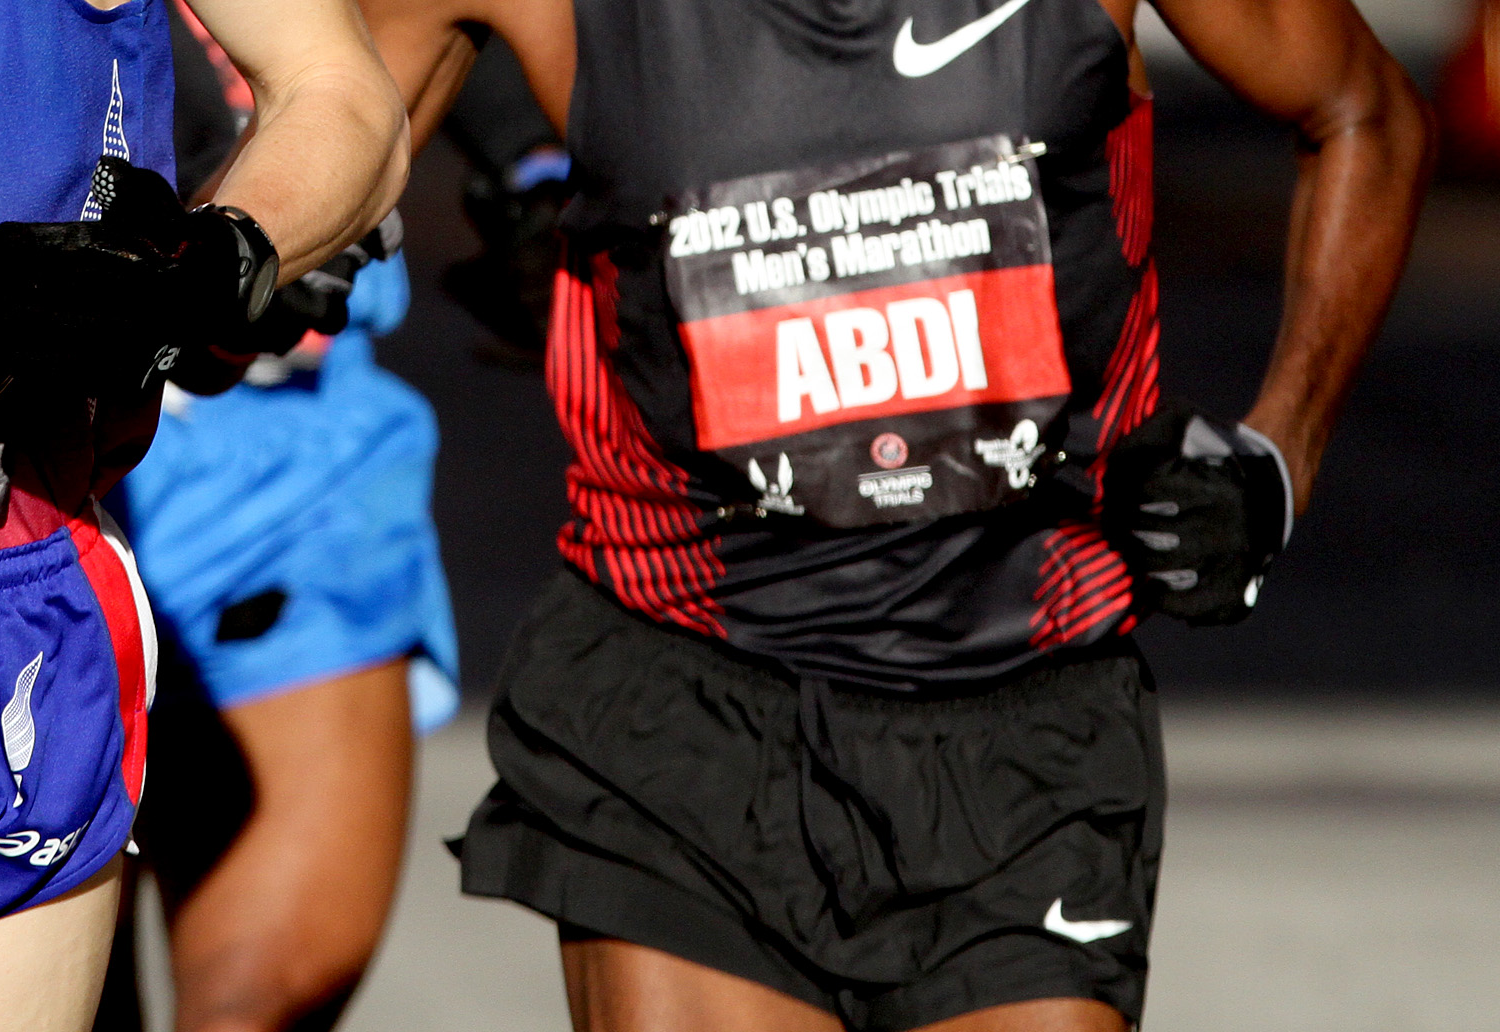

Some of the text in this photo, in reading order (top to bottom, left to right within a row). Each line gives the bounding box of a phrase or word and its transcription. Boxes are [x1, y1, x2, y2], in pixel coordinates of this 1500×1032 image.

[669, 161, 1032, 258] 2012 U.S. Olympic Trials
[731, 218, 992, 296] Men's Marathon
[776, 289, 988, 423] ABDI
